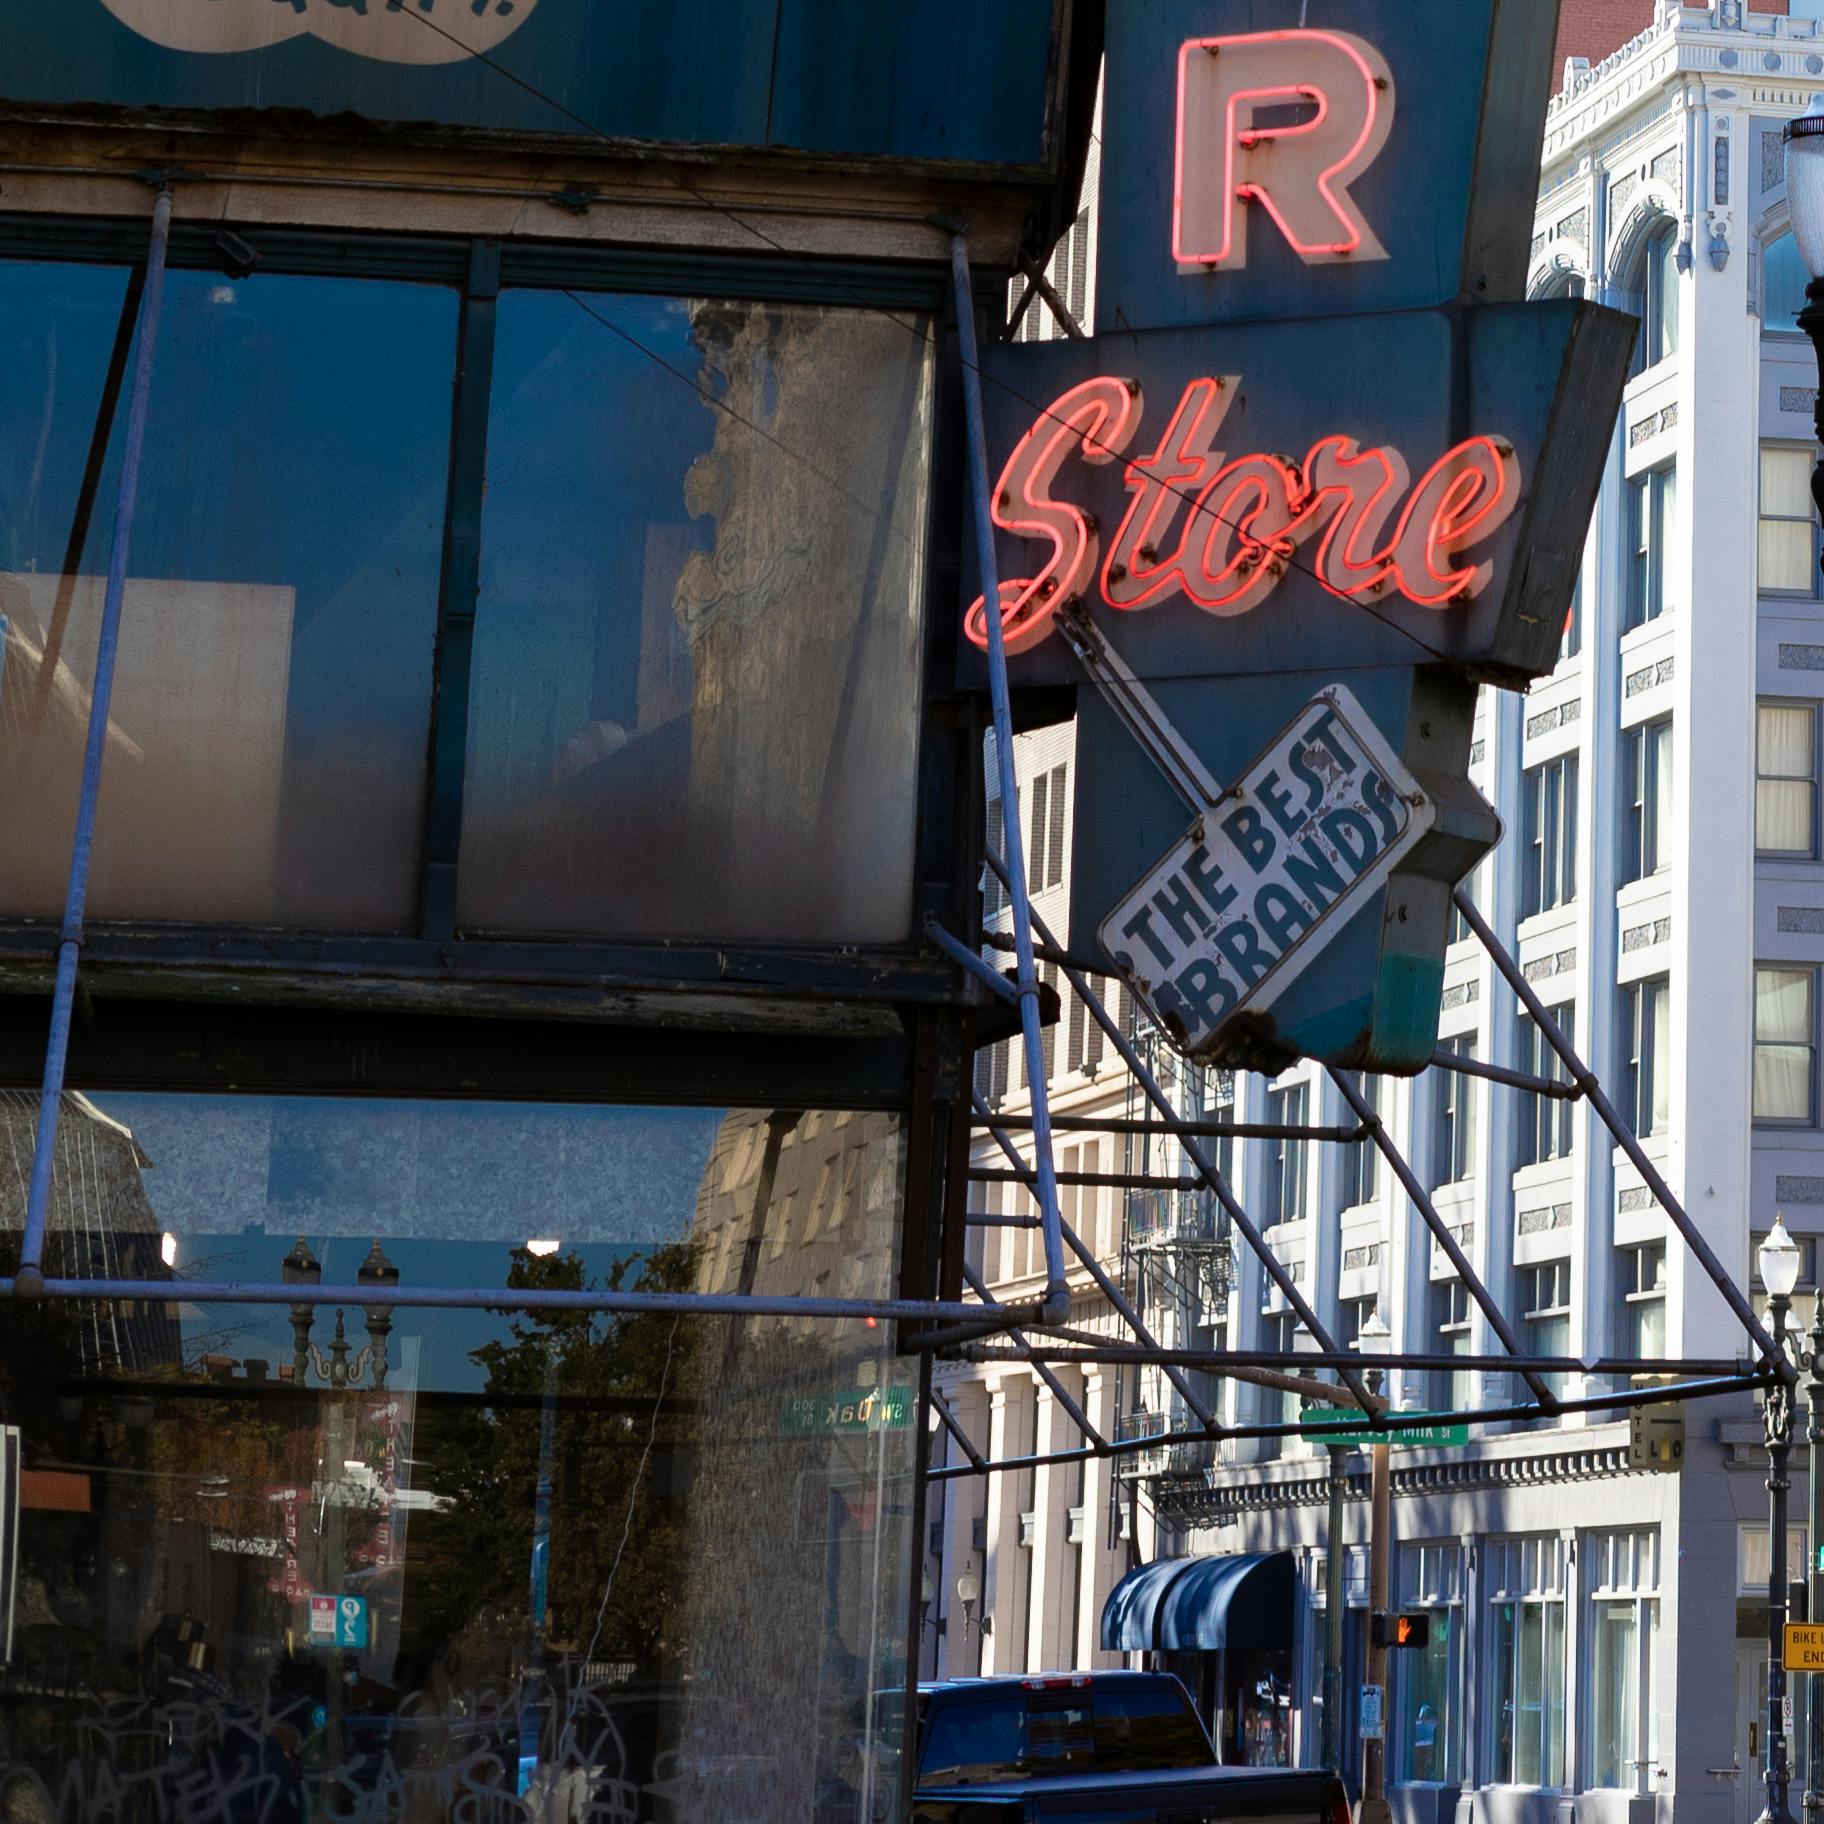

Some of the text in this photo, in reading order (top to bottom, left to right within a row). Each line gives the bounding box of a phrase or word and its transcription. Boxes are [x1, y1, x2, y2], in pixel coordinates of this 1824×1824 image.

[964, 375, 1522, 657] Store
[1123, 709, 1361, 972] THE BEST
[1172, 770, 1400, 1022] BRANDS
[1792, 1631, 1817, 1644] BIKE
